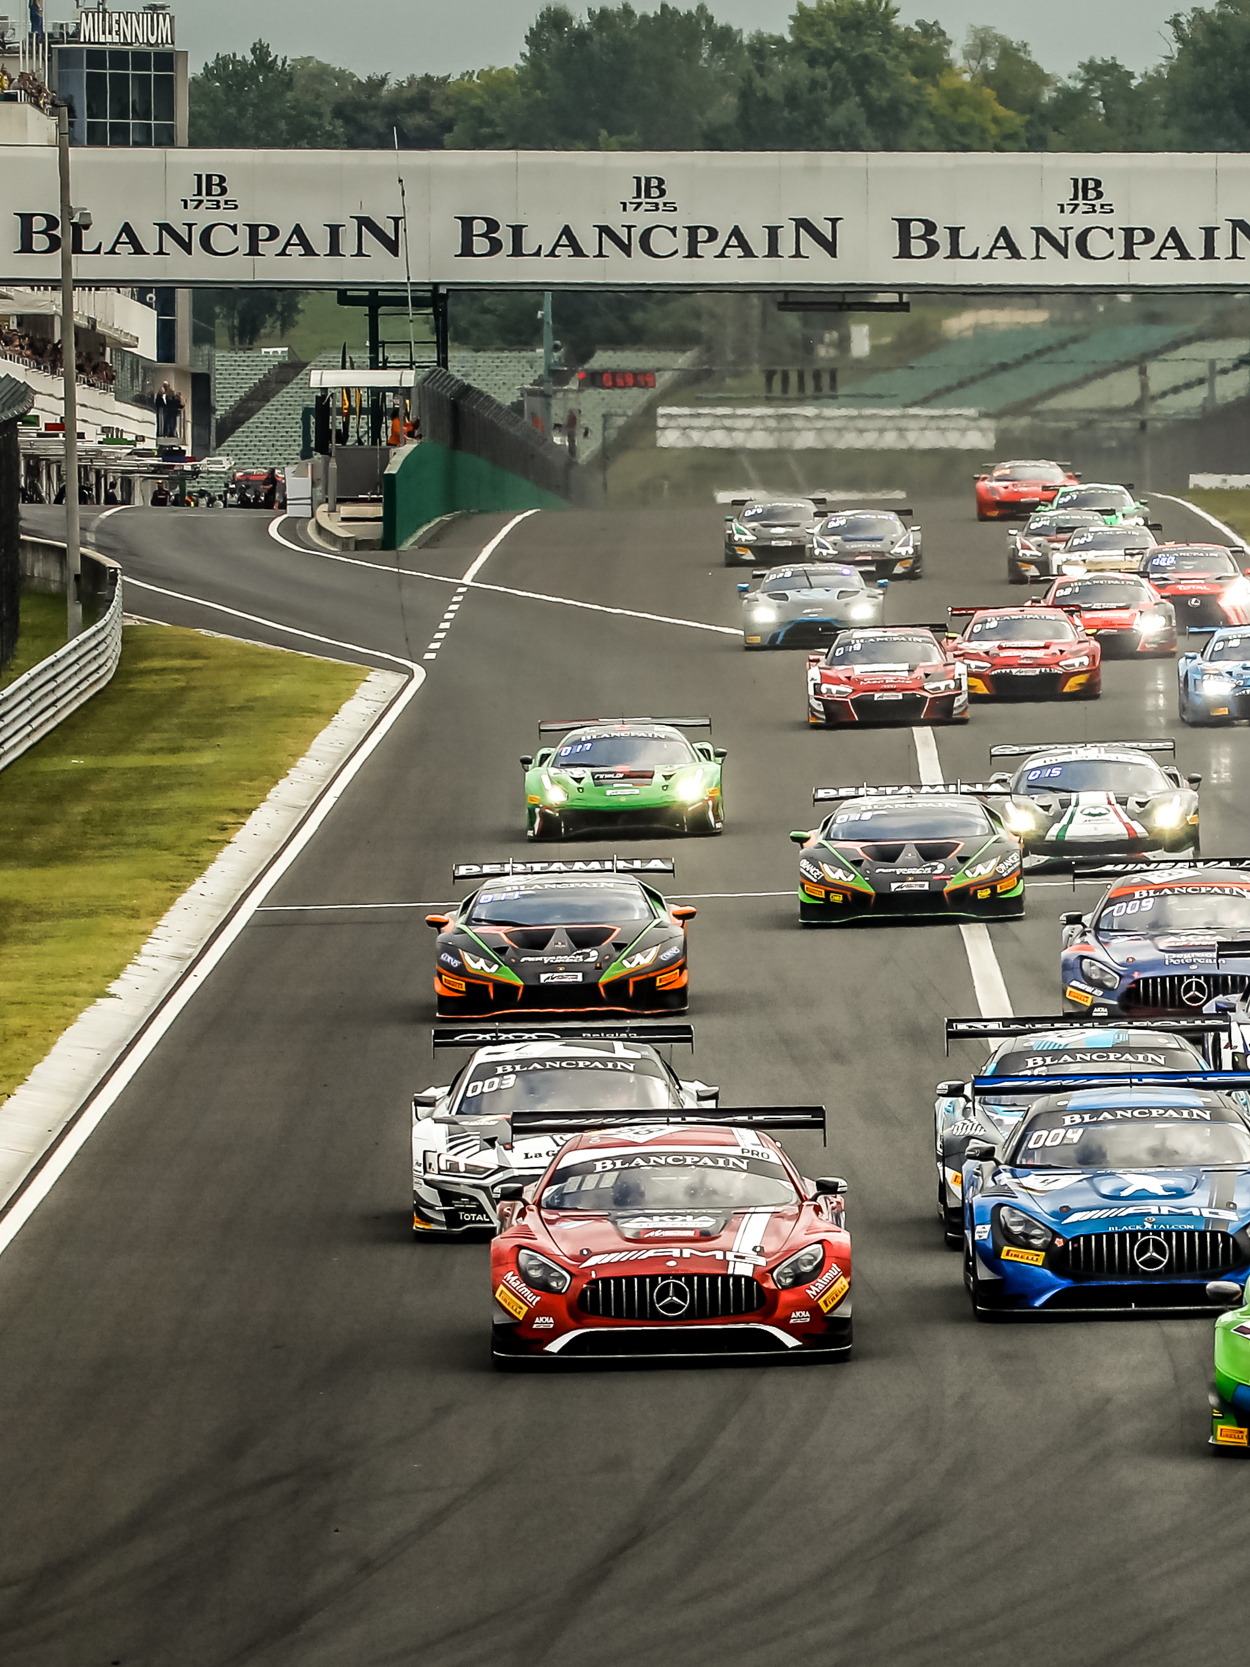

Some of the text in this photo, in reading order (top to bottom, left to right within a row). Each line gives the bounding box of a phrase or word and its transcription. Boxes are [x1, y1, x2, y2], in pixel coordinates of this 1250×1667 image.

[80, 11, 174, 45] MILLENNIUM
[180, 199, 240, 211] 1735
[619, 201, 678, 213] 1735
[1057, 203, 1115, 215] 1735
[12, 211, 404, 257] BLANCPAIN
[454, 214, 844, 261] BLANCPAIN
[581, 732, 666, 742] BLANCPAIN
[817, 783, 1008, 798] PERTAMINA
[458, 859, 667, 876] PERTAMINA
[1134, 886, 1248, 899] BLANCPAIN
[1112, 898, 1155, 917] 009
[495, 1060, 636, 1075] BLANCPAIN
[1025, 1052, 1166, 1068] BLANCPAIN
[465, 1073, 517, 1098] 003
[1062, 1108, 1212, 1127] BLANCPAIN
[1027, 1128, 1084, 1150] 004
[523, 1151, 543, 1160] La
[741, 1148, 770, 1160] PRO
[593, 1154, 750, 1174] BLANCPAIN
[458, 1211, 490, 1222] TOTAL
[1118, 1205, 1240, 1222] AMG
[637, 1248, 767, 1267] AMG
